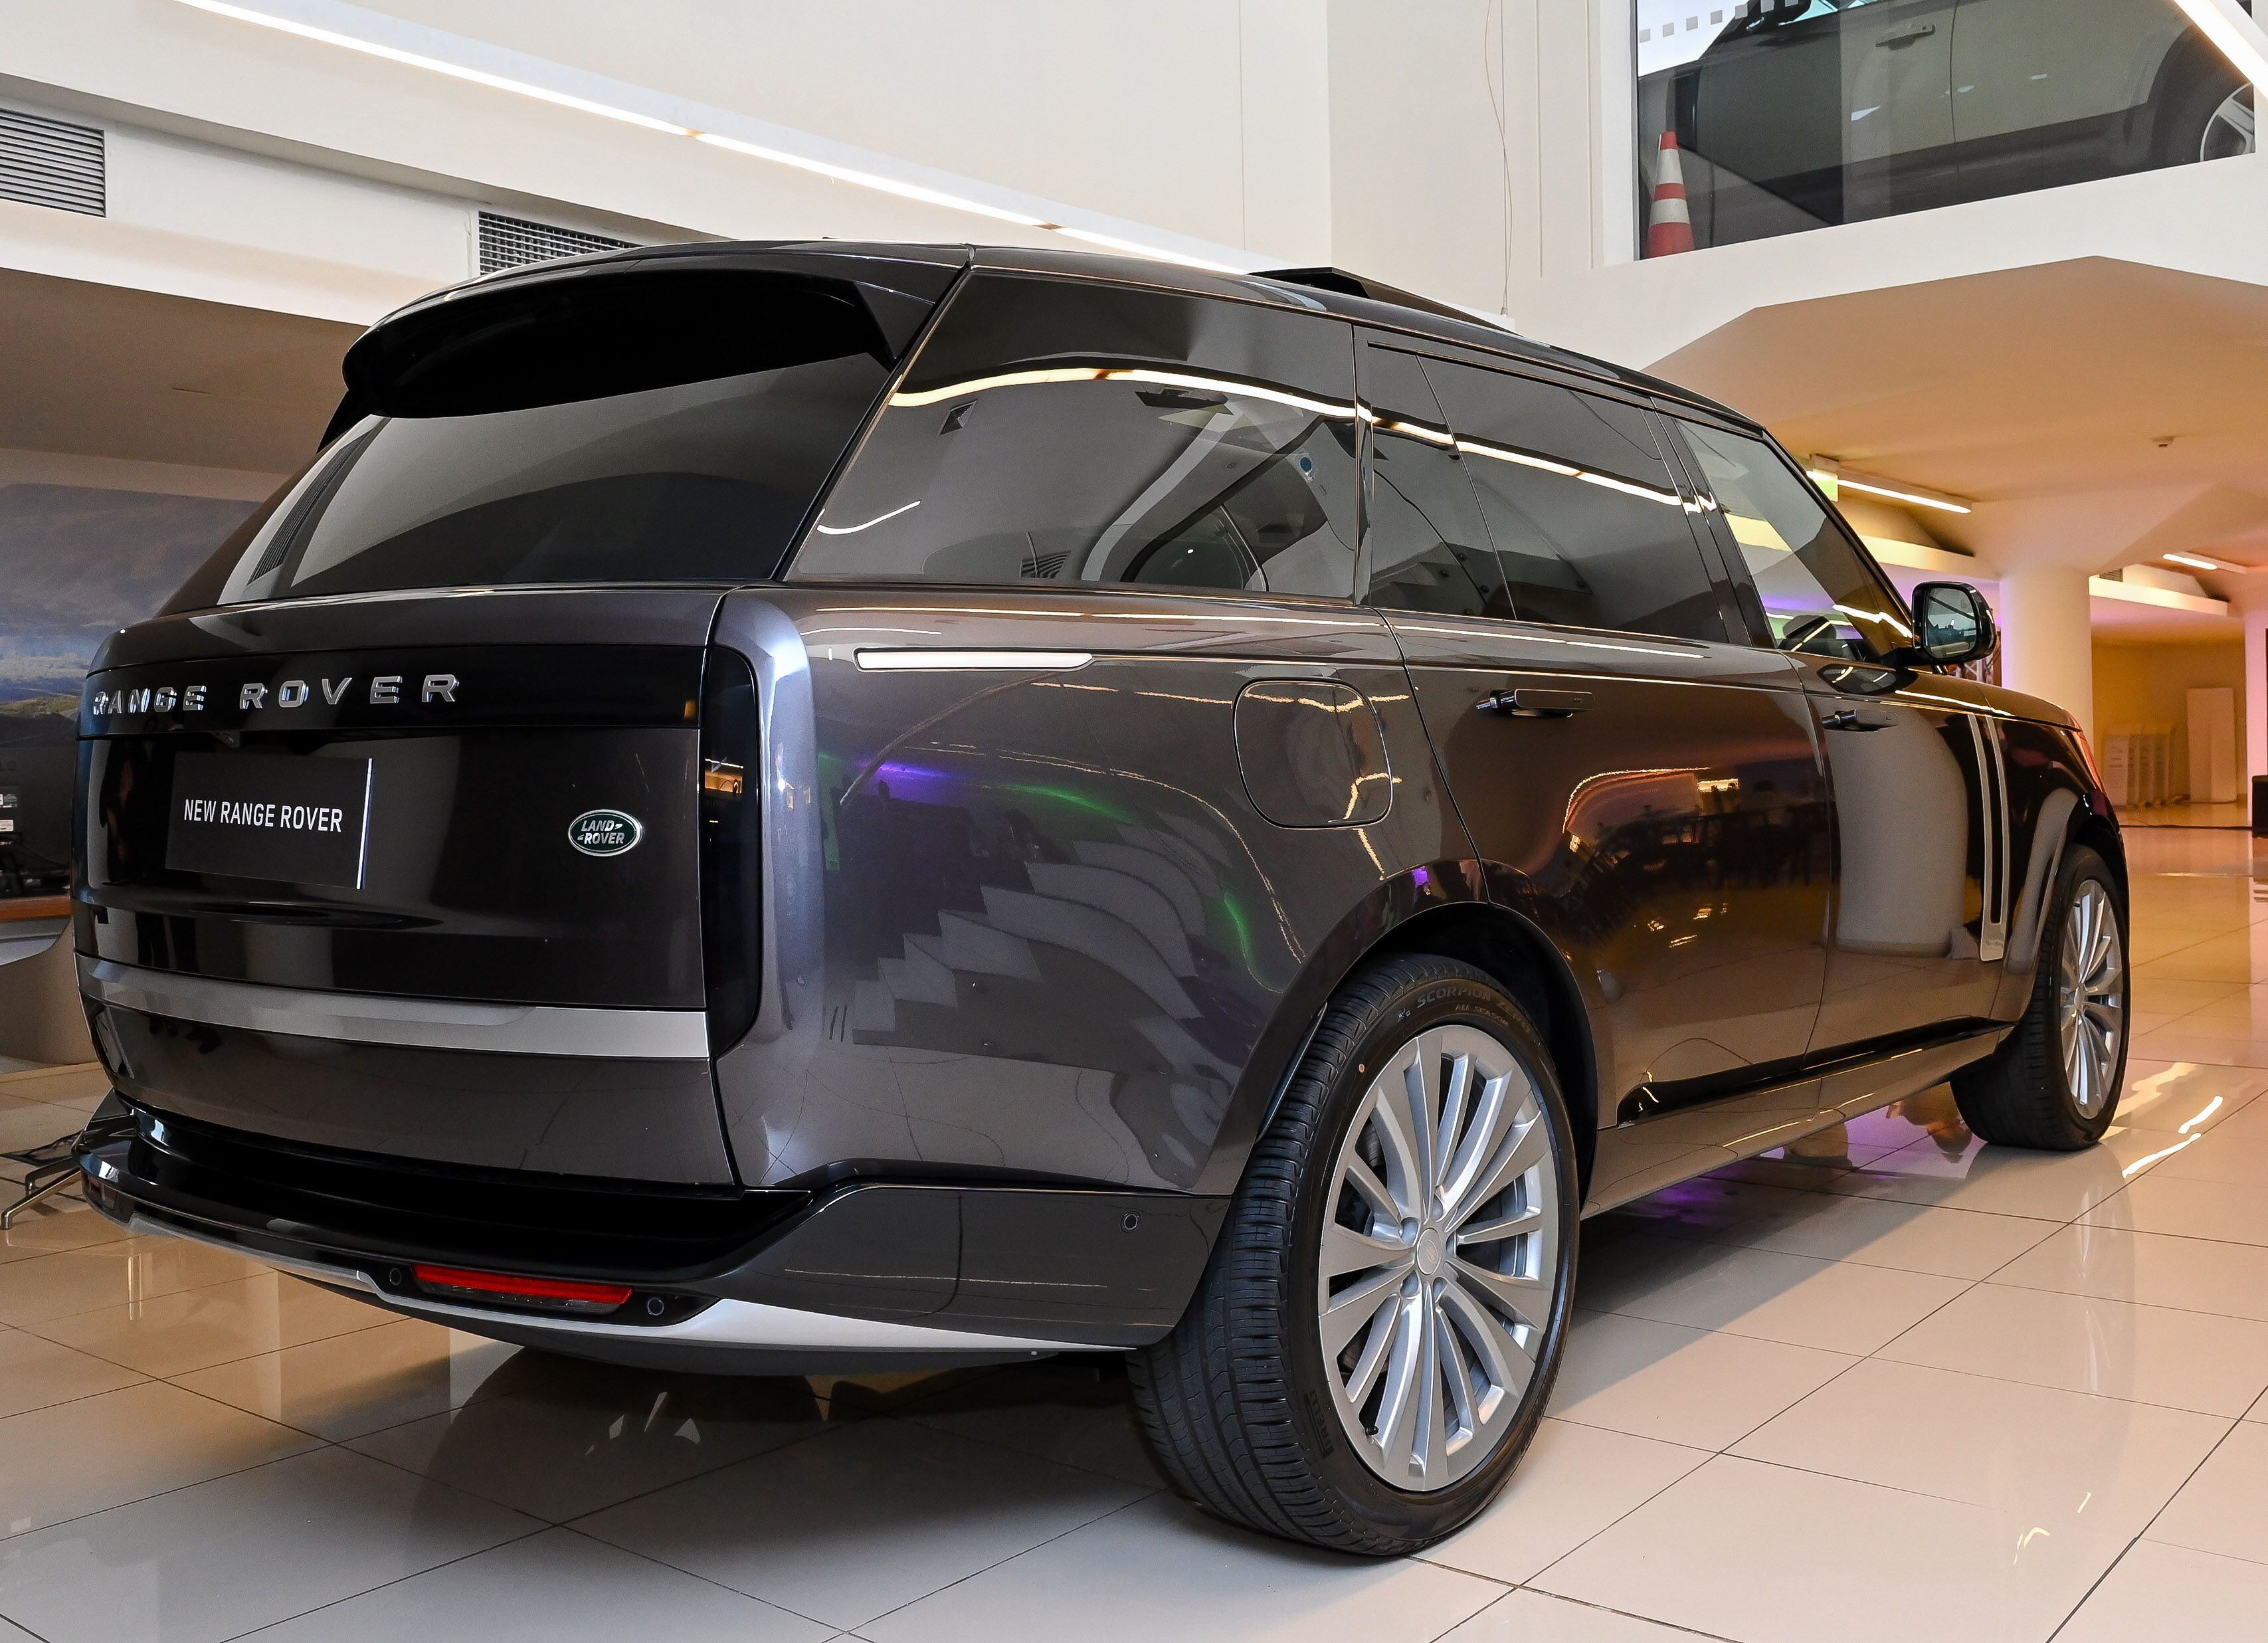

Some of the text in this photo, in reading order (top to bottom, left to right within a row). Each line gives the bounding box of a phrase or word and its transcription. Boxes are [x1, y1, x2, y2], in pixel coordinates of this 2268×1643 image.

[93, 674, 459, 715] RANGE ROVER
[184, 799, 343, 832] NEW RANGE ROVER
[581, 820, 614, 831] LAND
[584, 832, 624, 844] ROVER
[1417, 987, 1491, 1009] SCORPION
[1473, 1005, 1509, 1027] SEASON
